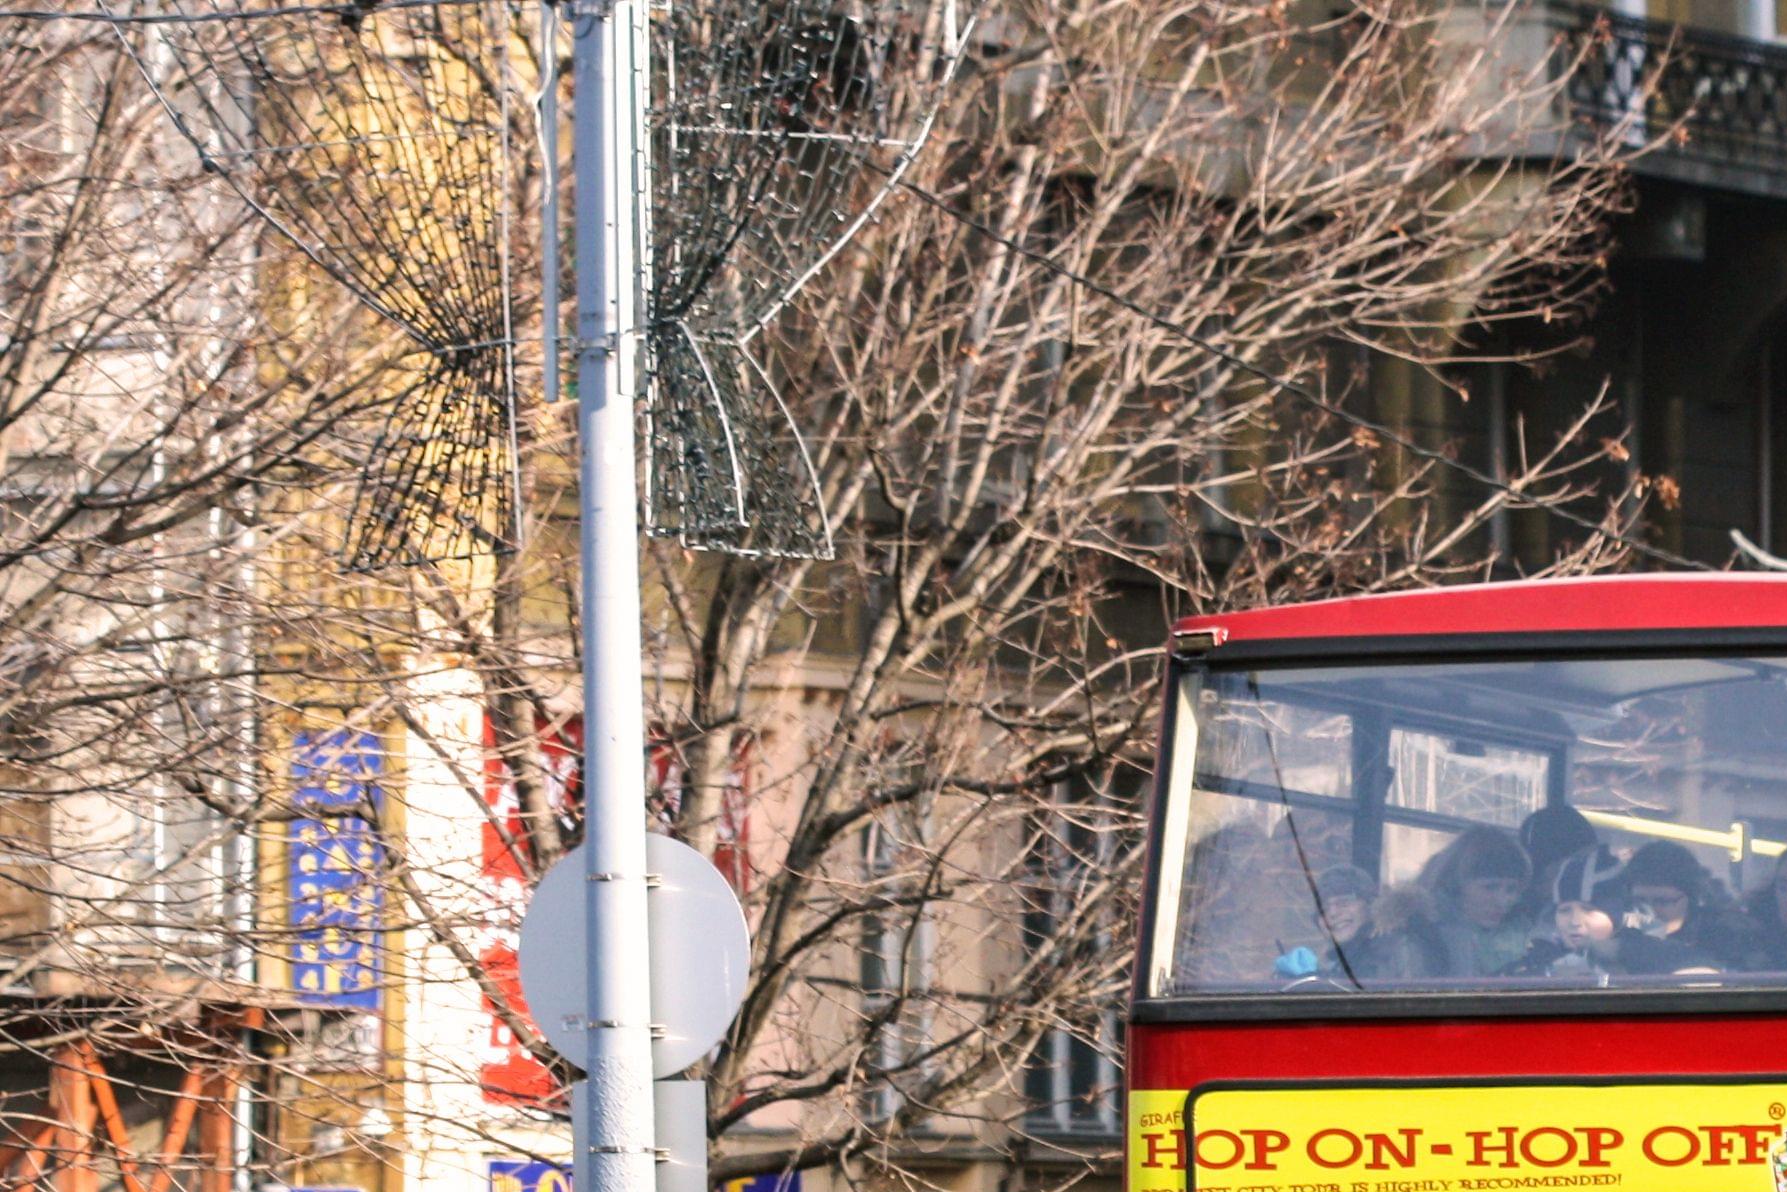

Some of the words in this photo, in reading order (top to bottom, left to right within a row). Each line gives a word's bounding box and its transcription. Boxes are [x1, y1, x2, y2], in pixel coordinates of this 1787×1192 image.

[1140, 1110, 1196, 1127] GIRAF
[1141, 1128, 1291, 1170] HOP
[1306, 1128, 1424, 1170] ON
[1464, 1125, 1624, 1168] HOP
[1642, 1123, 1782, 1167] OFF
[1375, 1179, 1453, 1192] HIGHLY
[1457, 1173, 1624, 1190] RECOMMENDED!
